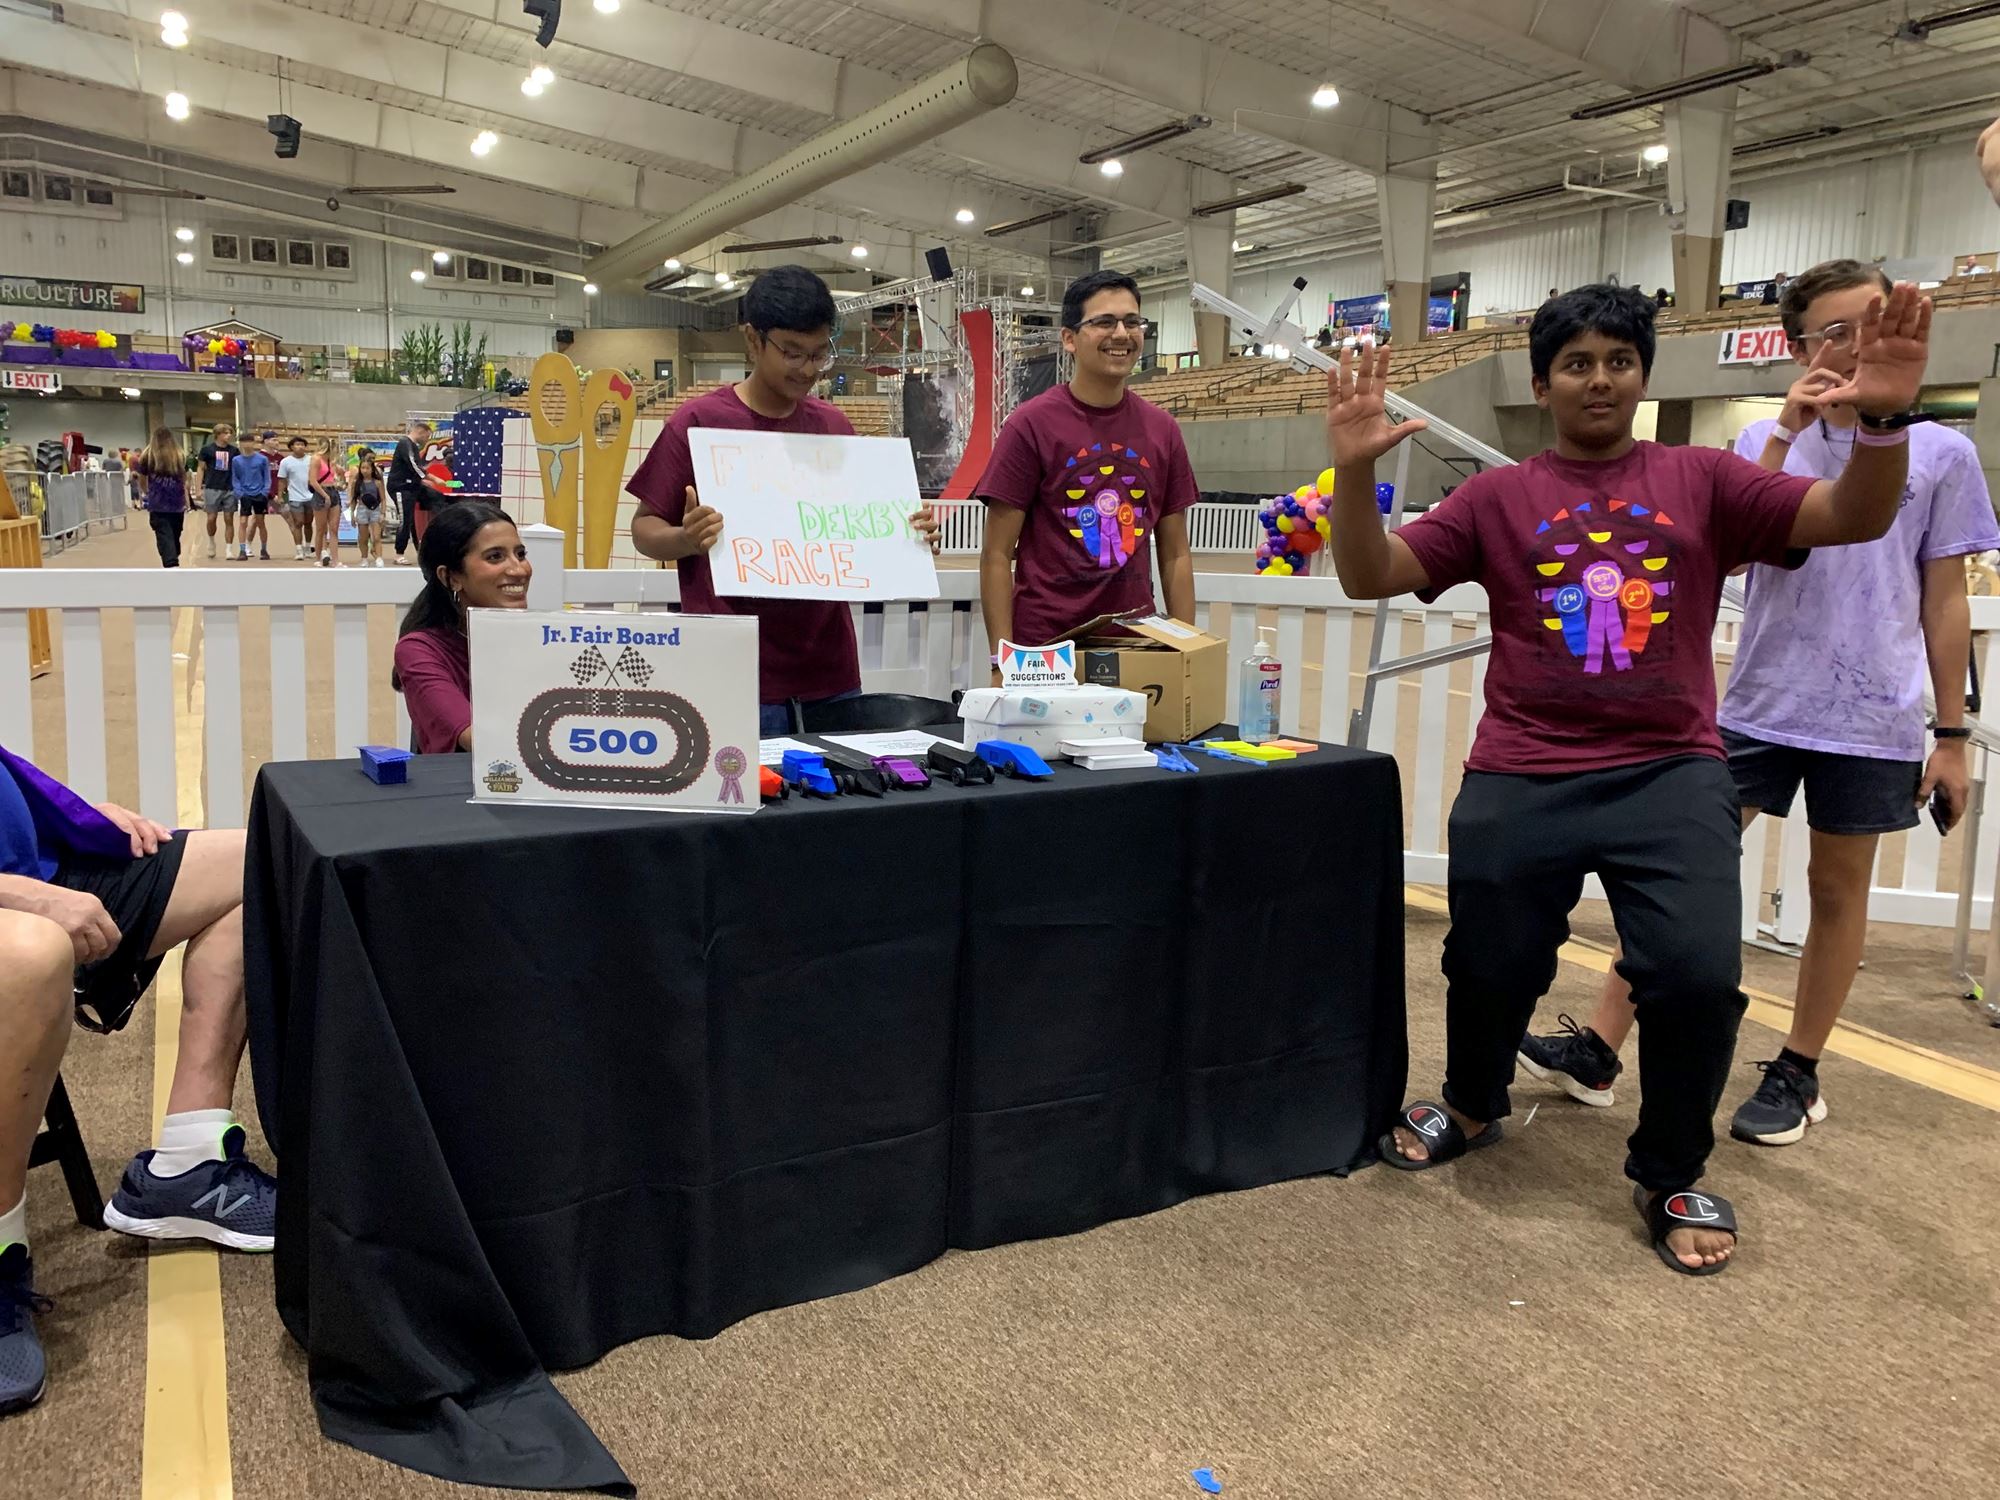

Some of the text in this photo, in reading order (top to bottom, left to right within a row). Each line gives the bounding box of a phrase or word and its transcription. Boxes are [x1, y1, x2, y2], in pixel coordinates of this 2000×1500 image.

[1, 282, 122, 306] RICULTURE
[14, 373, 49, 388] EXIT
[797, 500, 920, 540] DERBY
[732, 537, 870, 589] RACE
[1562, 592, 1578, 606] 1st
[1628, 588, 1645, 602] 2nd
[542, 625, 681, 647] Jr. Fair Board
[1027, 660, 1046, 668] FAIR
[1010, 673, 1066, 681] SUGGESTIONS
[569, 728, 658, 755] 500
